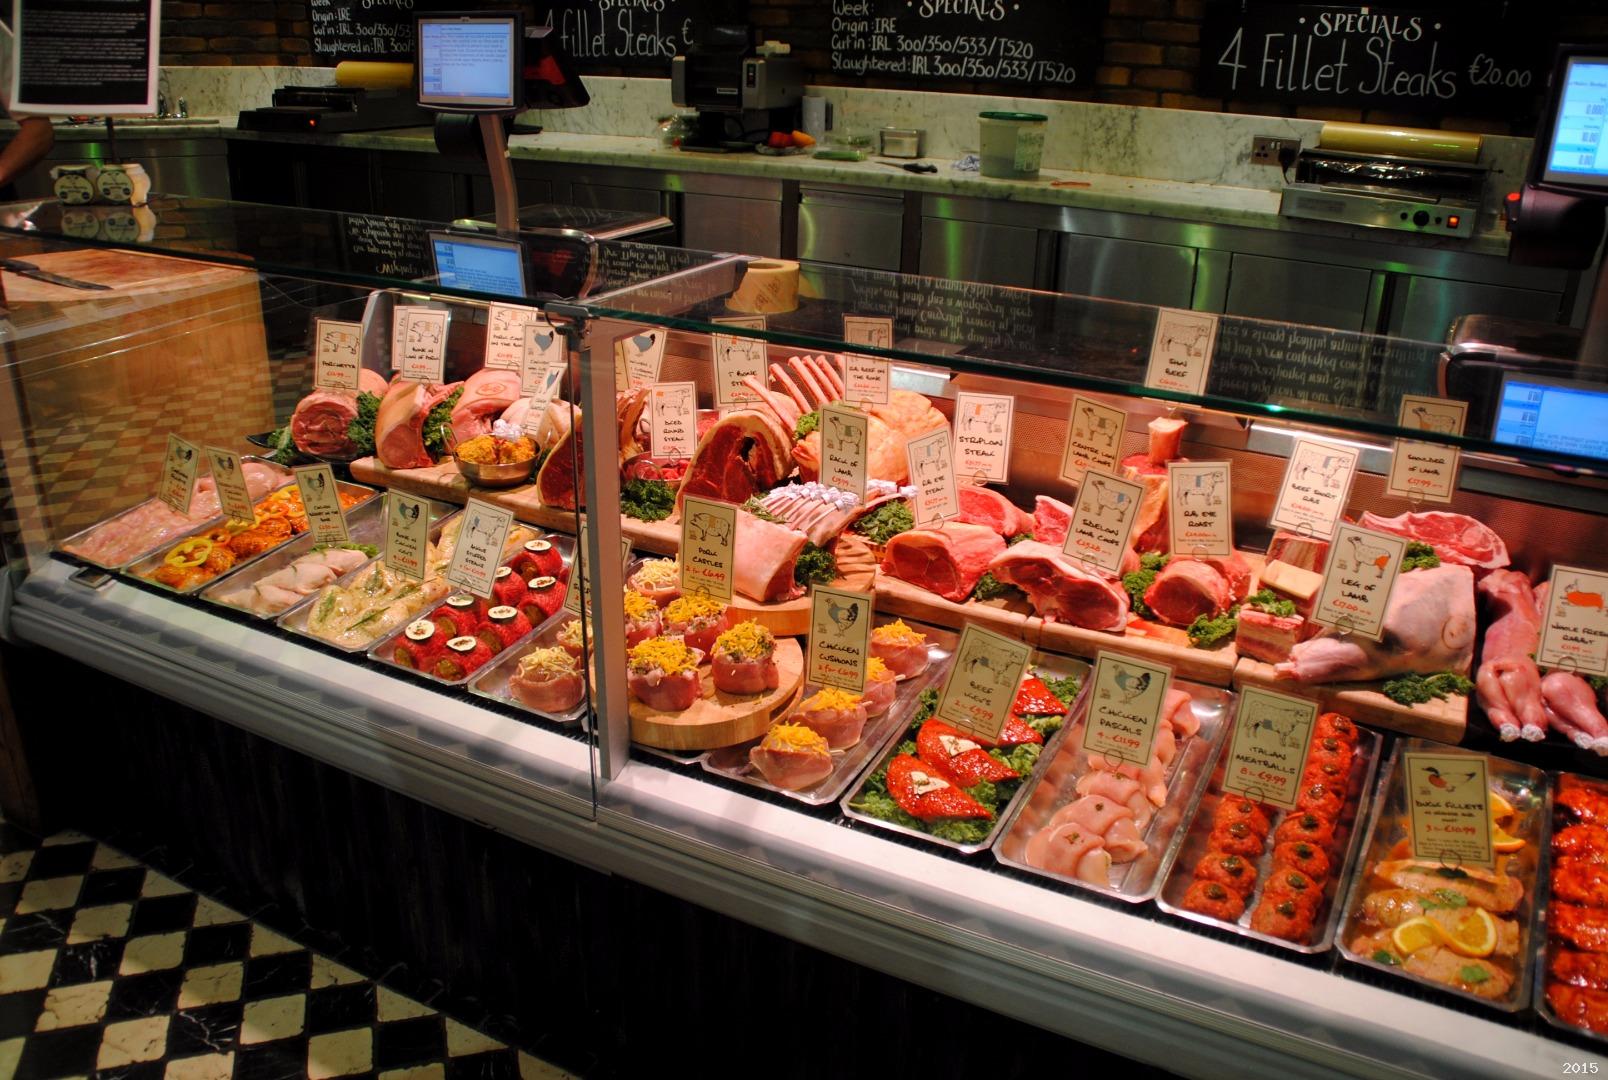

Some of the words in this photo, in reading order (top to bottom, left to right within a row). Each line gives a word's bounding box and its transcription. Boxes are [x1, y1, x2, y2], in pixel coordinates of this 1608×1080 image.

[919, 0, 1005, 21] SPECIALS
[1313, 12, 1423, 41] SPECIALS
[1217, 26, 1247, 91] 4
[1260, 33, 1349, 92] Fillet
[1358, 36, 1458, 99] Steaks
[1468, 52, 1532, 88] €20.00
[963, 447, 996, 458] STEAK
[1187, 520, 1214, 528] ROAST
[692, 556, 723, 569] CASTLES
[1341, 577, 1362, 589] LEG
[1341, 590, 1369, 604] LAMB
[819, 640, 860, 656] CHICKEN
[819, 653, 859, 668] CUSHIONS
[1098, 705, 1148, 725] CHICKEN
[1099, 718, 1142, 737] PASCALS
[1235, 754, 1296, 776] MEATBALLS
[1240, 767, 1249, 776] 8
[1257, 771, 1288, 787] €9.99
[1444, 801, 1484, 811] FILLETS
